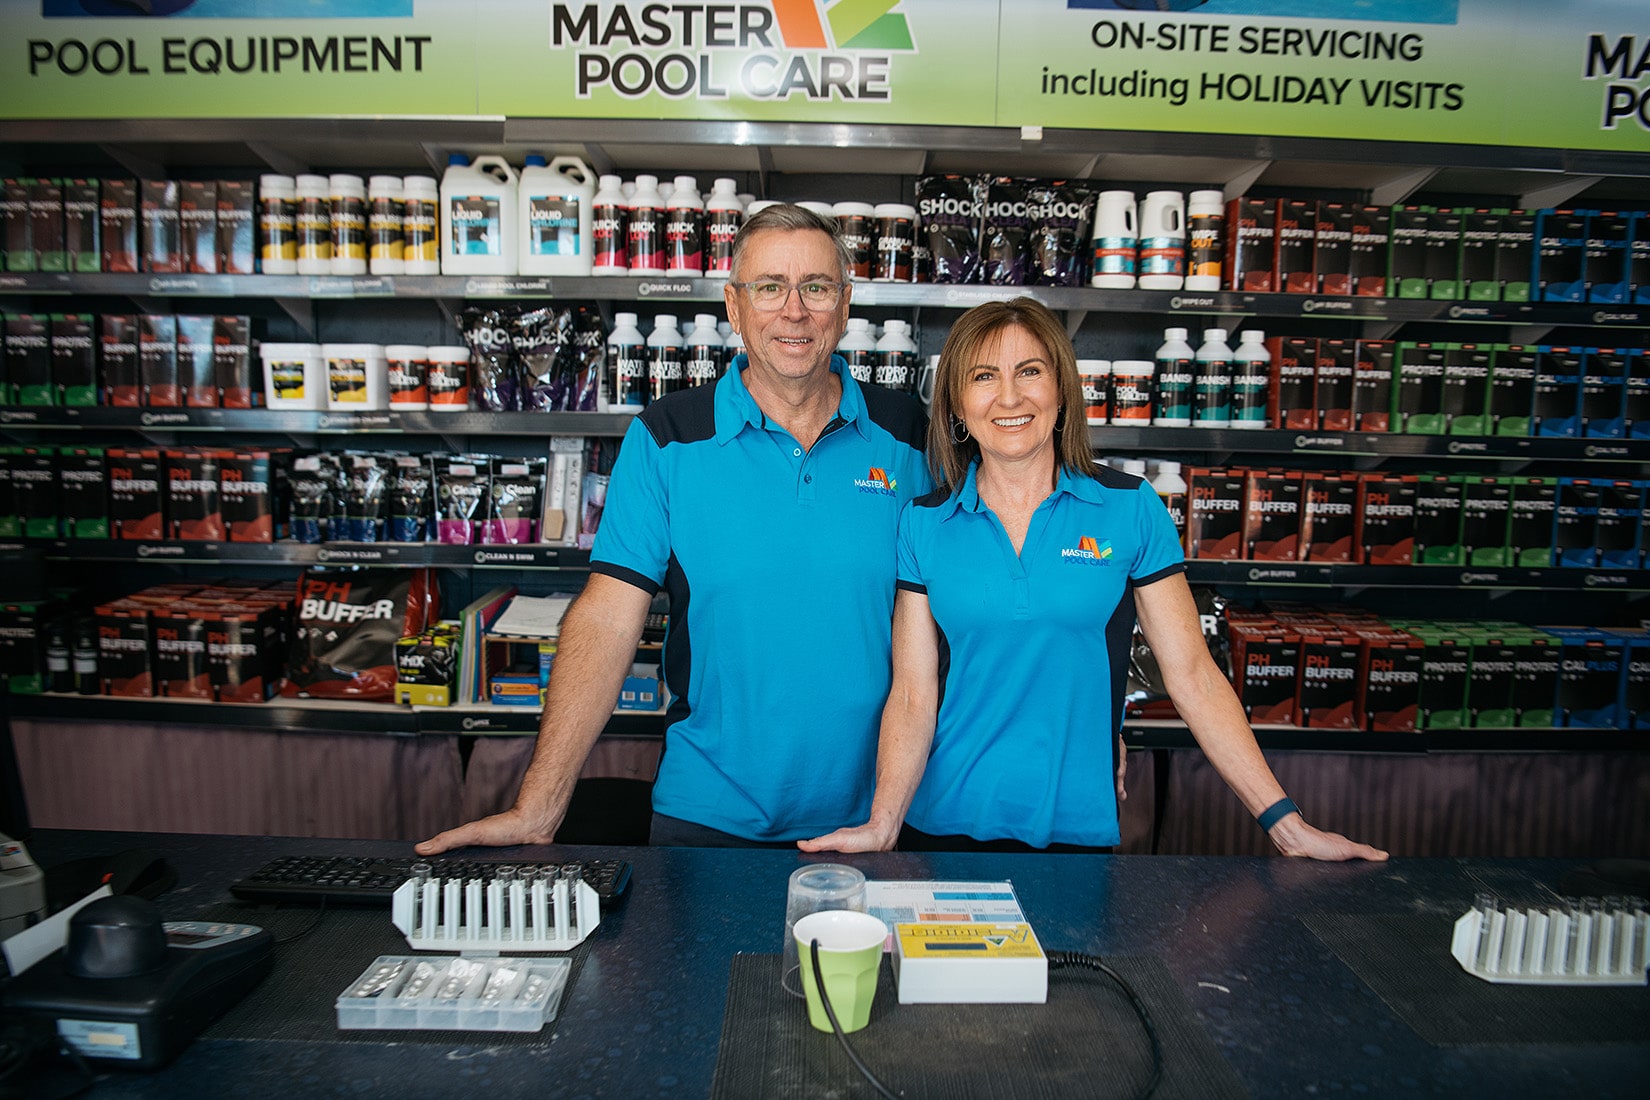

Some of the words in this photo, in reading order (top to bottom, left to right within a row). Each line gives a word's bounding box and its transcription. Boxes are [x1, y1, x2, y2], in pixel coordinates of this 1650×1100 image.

[552, 4, 774, 47] MASTER
[1091, 20, 1229, 53] ON-SITE
[1238, 26, 1425, 63] SERVICING
[28, 38, 149, 76] POOL
[162, 36, 432, 75] EQUIPMENT
[578, 54, 727, 97] POOL
[741, 55, 889, 99] CARE
[1041, 67, 1190, 106] including
[1199, 73, 1352, 106] HOLIDAY
[1361, 79, 1465, 112] VISITS
[919, 198, 981, 217] SHOCK
[452, 210, 483, 222] LIQUID
[531, 210, 563, 222] LIQUID
[630, 222, 656, 233] UICK
[1191, 230, 1219, 241] WIPE
[649, 360, 682, 371] WATER
[1401, 365, 1444, 377] PROTEC
[649, 369, 683, 380] POLISH
[1445, 366, 1488, 378] PROTEC
[1492, 367, 1535, 379] PROTEC
[506, 484, 536, 495] Clean
[854, 479, 885, 489] MASTER
[1193, 487, 1215, 499] PH
[1252, 489, 1273, 501] PH
[1311, 491, 1330, 502] PH
[1367, 493, 1389, 505] PH
[1192, 499, 1240, 511] BUFFER
[1249, 501, 1297, 513] BUFFER
[1306, 502, 1352, 515] BUFFER
[1416, 498, 1460, 509] PROTEC
[1465, 499, 1509, 511] PROTEC
[1513, 500, 1556, 511] PROTEC
[1366, 504, 1414, 516] BUFFER
[1061, 548, 1094, 559] MASTER
[304, 580, 352, 602] PH
[299, 598, 394, 623] BUFFER
[1248, 653, 1270, 665] PH
[1306, 655, 1329, 667] PH
[1371, 658, 1393, 671] PH
[1246, 664, 1294, 677] BUFFER
[1423, 661, 1467, 672] PROTEC
[1471, 661, 1514, 672] PROTEC
[1515, 661, 1559, 673] PROTEC
[1305, 667, 1354, 679] BUFFER
[1369, 670, 1418, 683] BUFFER
